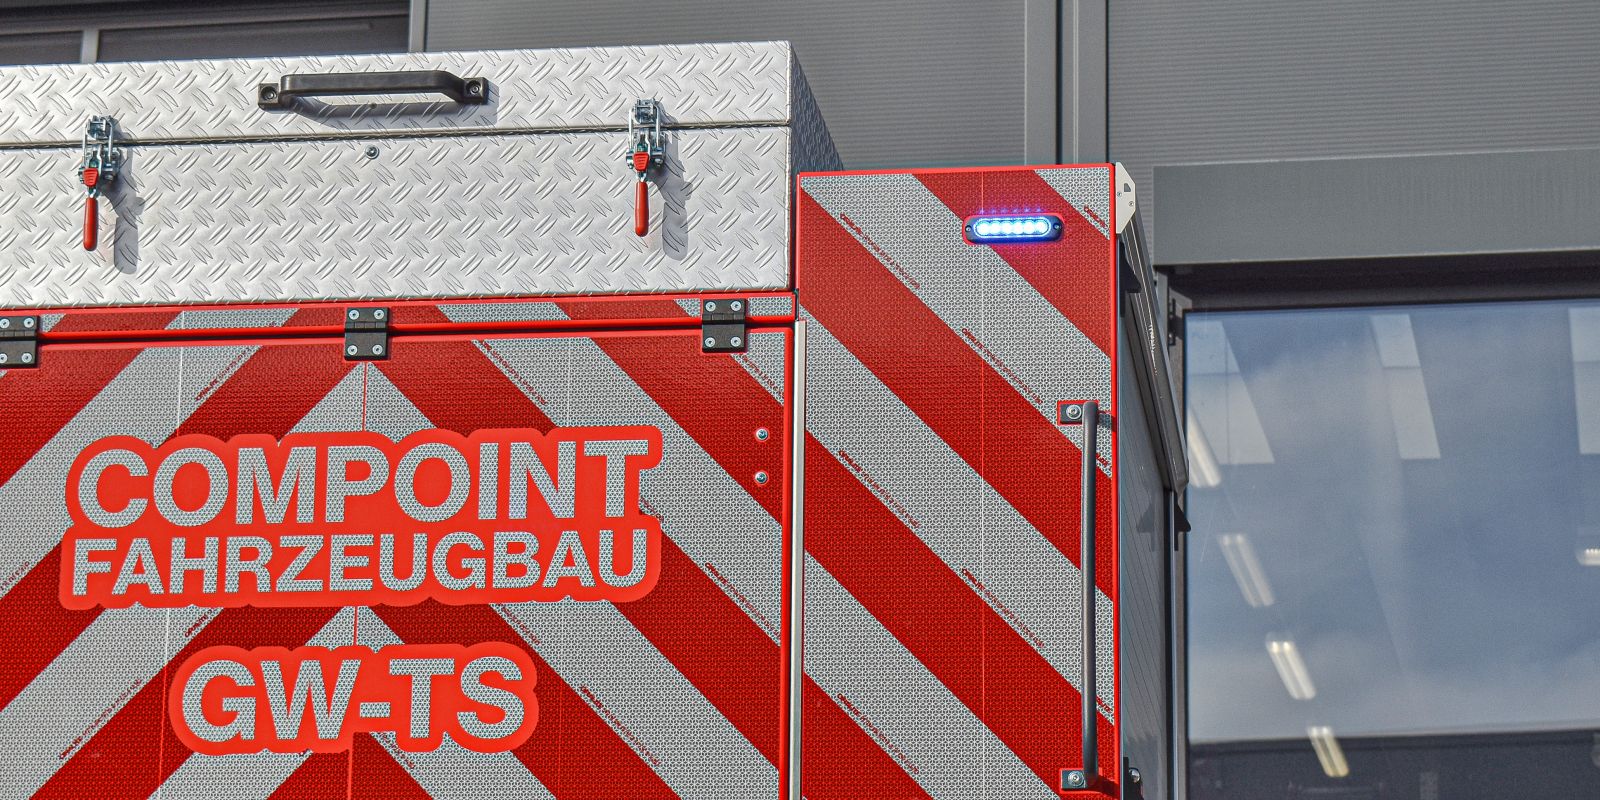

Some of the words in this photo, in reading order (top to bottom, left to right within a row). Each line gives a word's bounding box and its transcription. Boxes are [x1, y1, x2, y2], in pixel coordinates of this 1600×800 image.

[78, 440, 648, 528] COMPOINT
[72, 529, 647, 595] FAHRZEUGBAU
[182, 656, 525, 742] GW-TS
